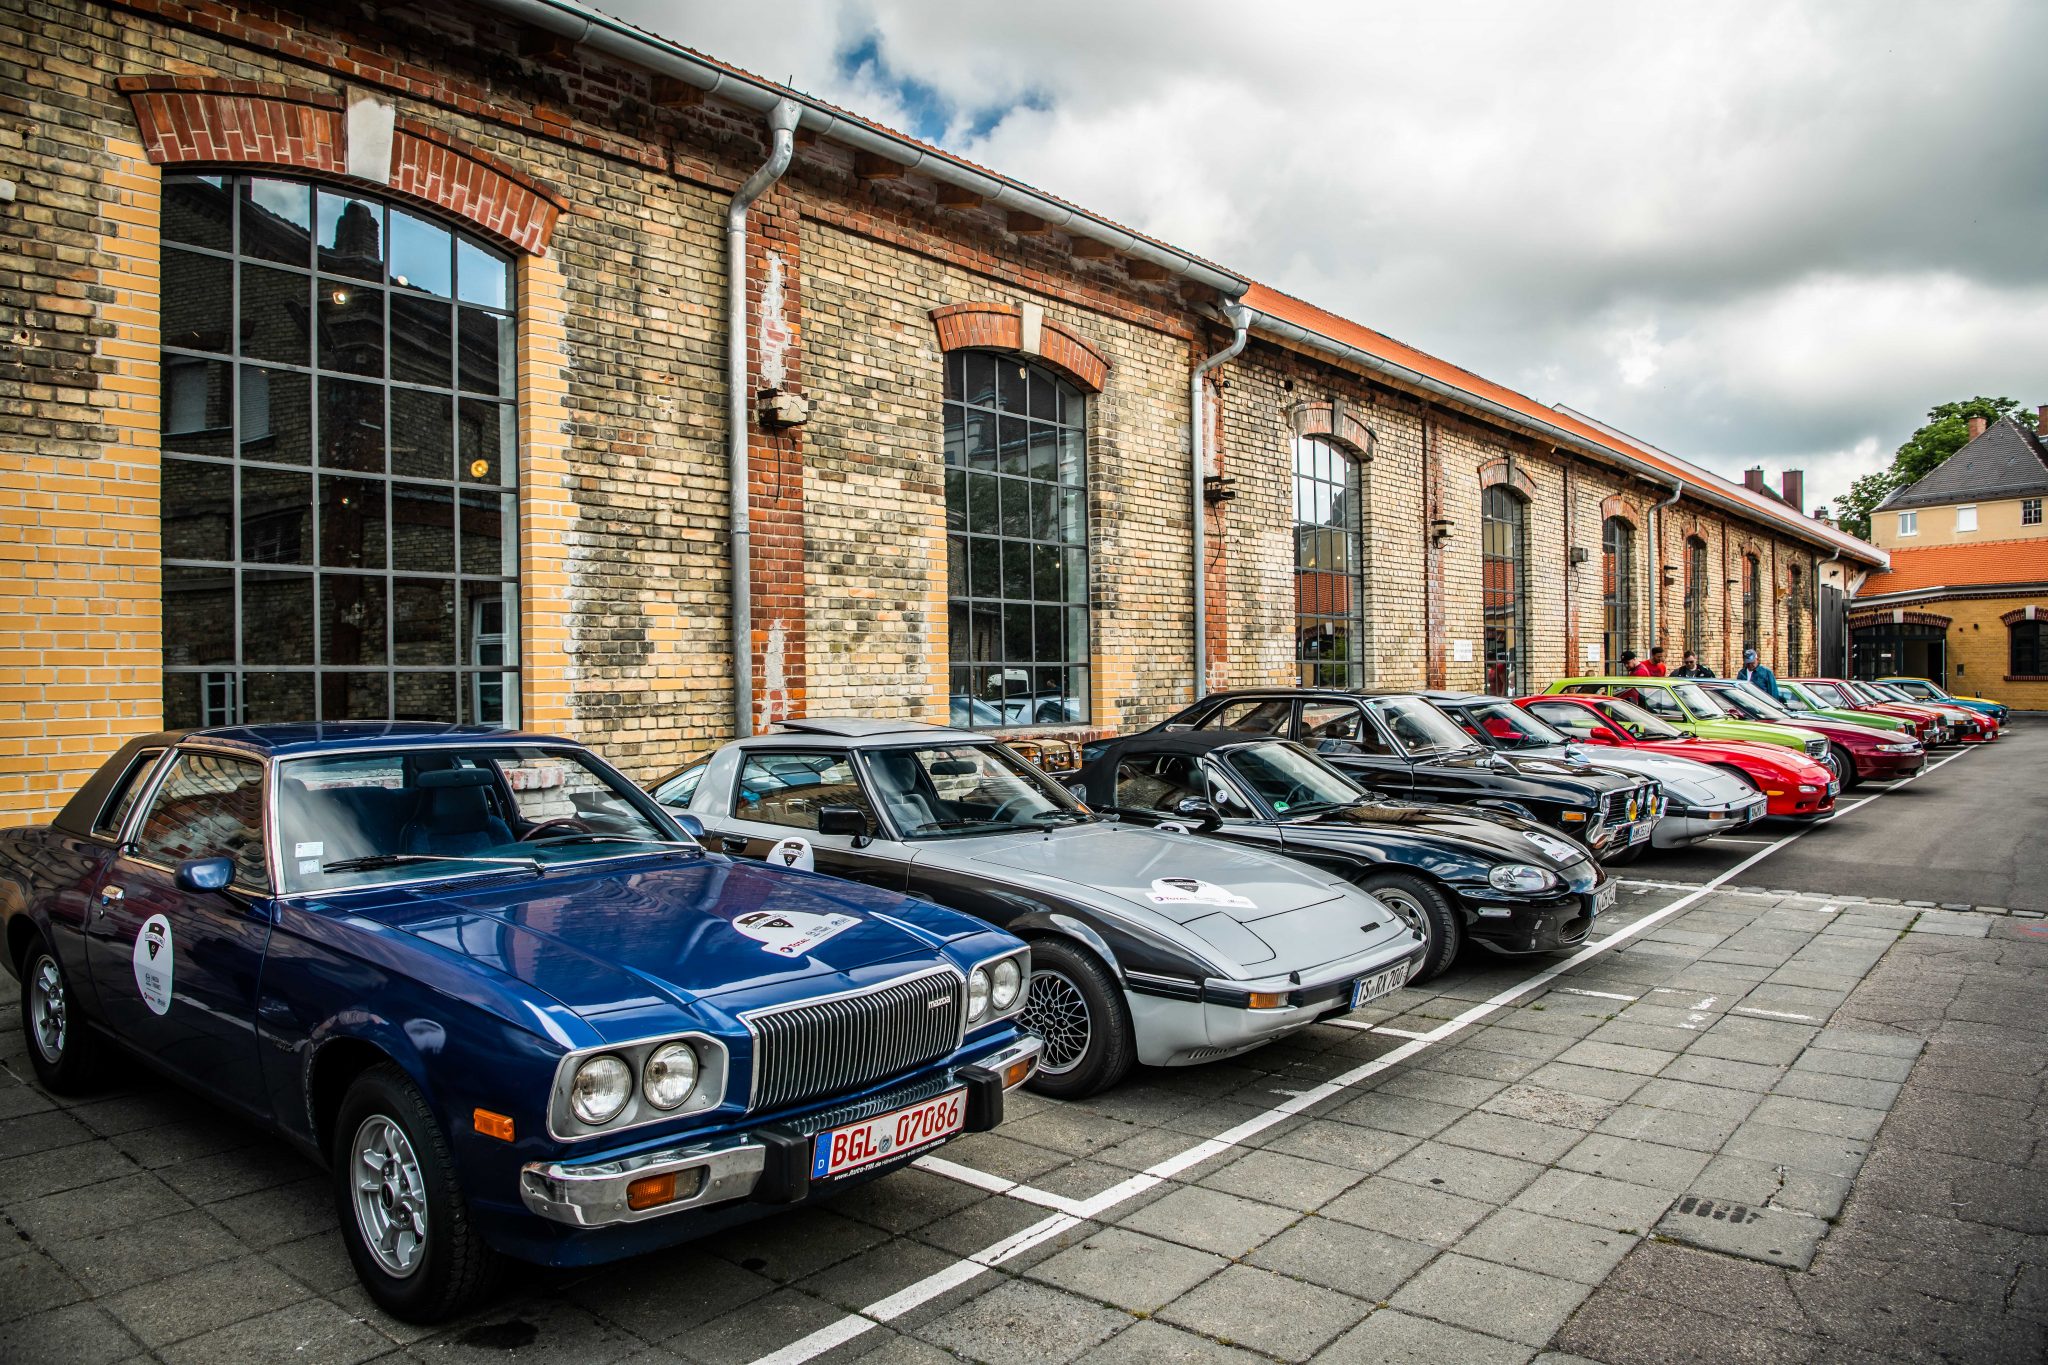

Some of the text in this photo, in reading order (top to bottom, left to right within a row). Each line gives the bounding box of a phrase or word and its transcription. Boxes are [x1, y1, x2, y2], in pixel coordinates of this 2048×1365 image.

[788, 938, 810, 948] TOTAL
[1359, 981, 1372, 1002] TS
[1374, 974, 1388, 994] RX
[928, 995, 951, 1009] mazda
[832, 1098, 959, 1167] BGL 07086
[817, 1159, 825, 1169] D
